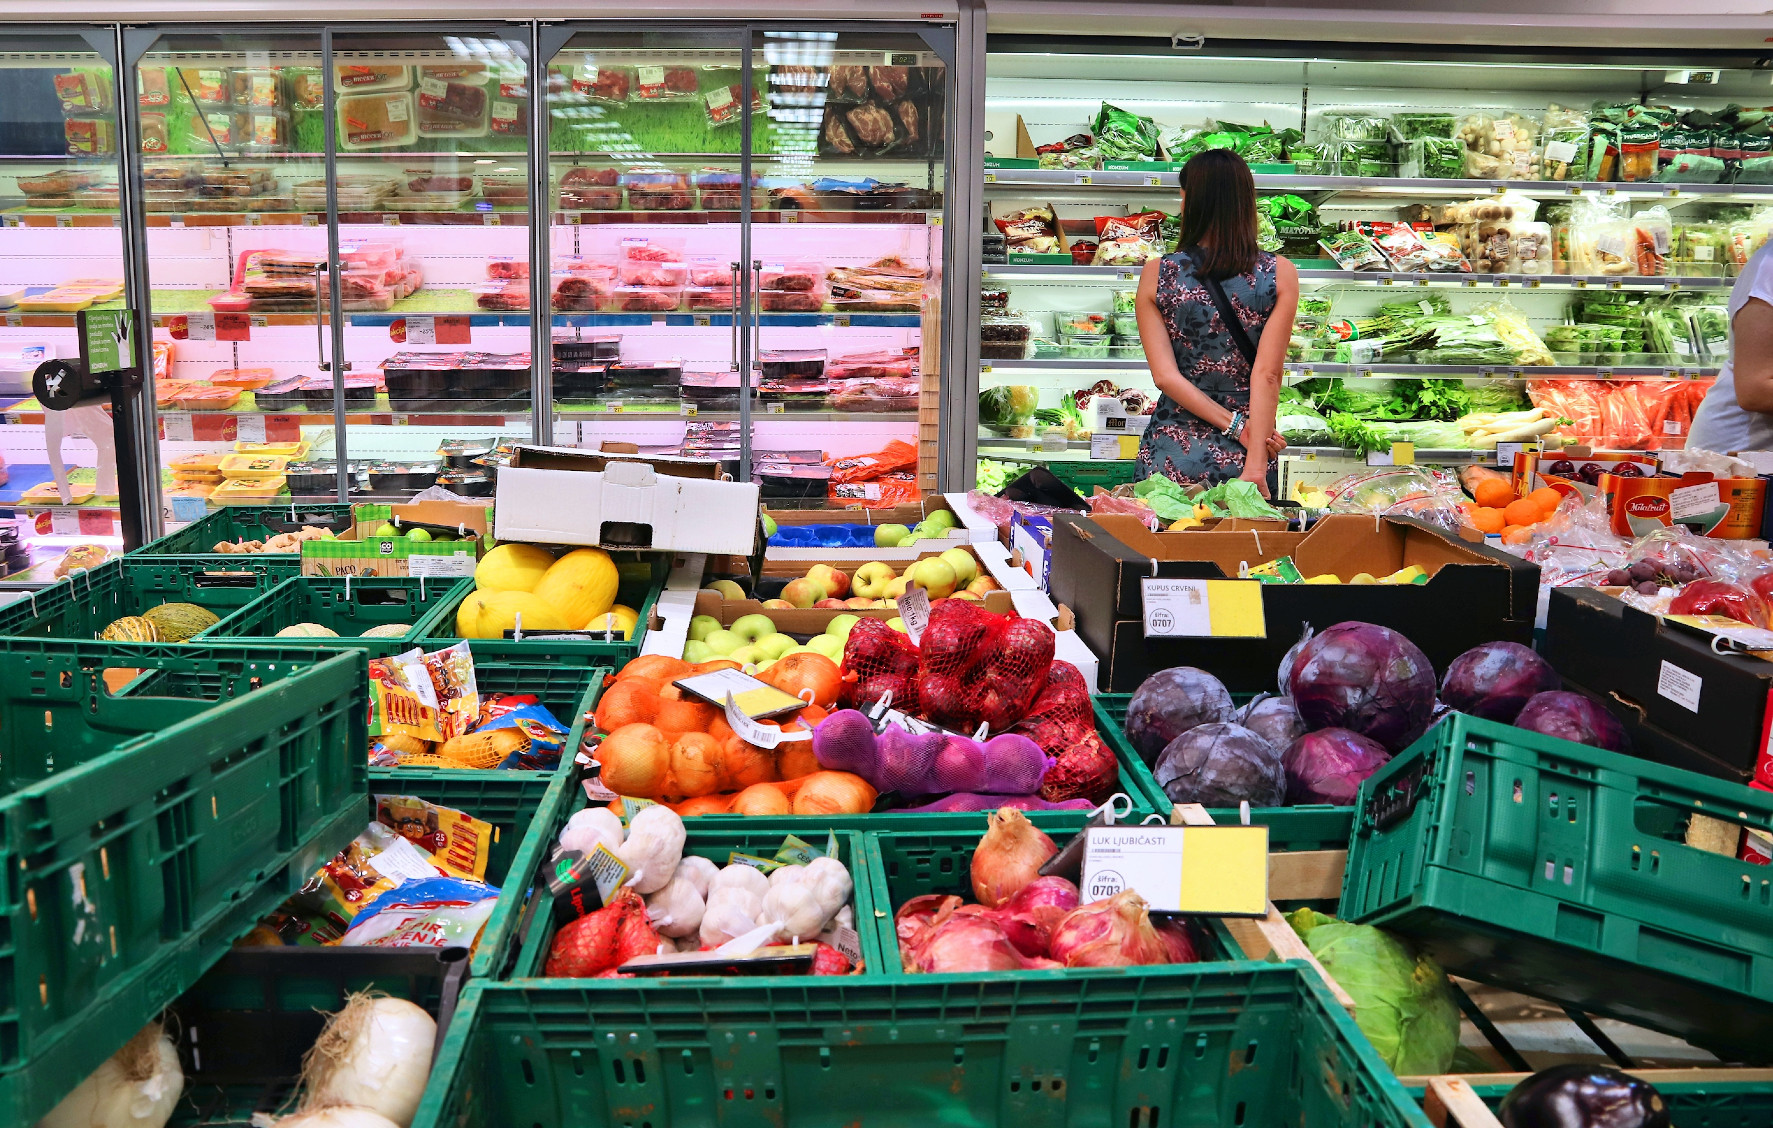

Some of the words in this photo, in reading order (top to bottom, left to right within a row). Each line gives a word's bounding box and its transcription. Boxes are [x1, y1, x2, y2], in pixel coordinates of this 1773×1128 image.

[1147, 584, 1170, 592] KUPUS
[1152, 619, 1172, 627] 0707
[1092, 836, 1111, 845] LUK
[1113, 834, 1166, 847] LJUBIČASTI
[1092, 885, 1120, 896] 0703
[837, 942, 858, 960] Neto
